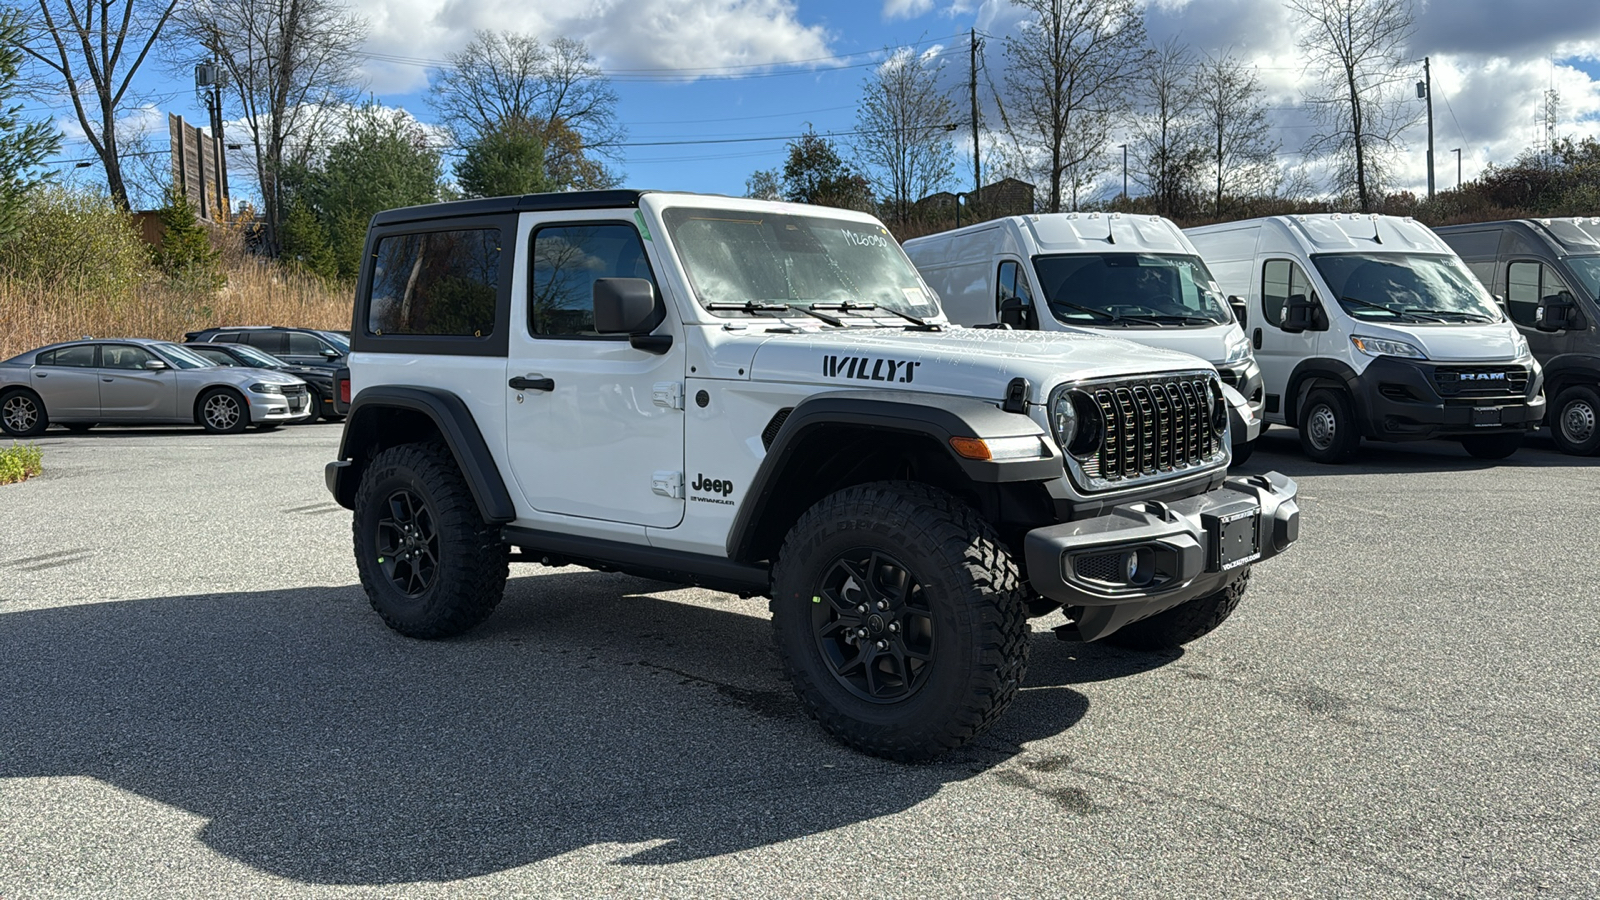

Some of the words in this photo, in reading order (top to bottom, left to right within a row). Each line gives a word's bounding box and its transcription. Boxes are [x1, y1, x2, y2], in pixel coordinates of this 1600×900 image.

[823, 355, 921, 383] WILLYS
[1460, 372, 1505, 381] RAM
[692, 473, 733, 497] Jeep
[696, 497, 735, 506] WRANGLER
